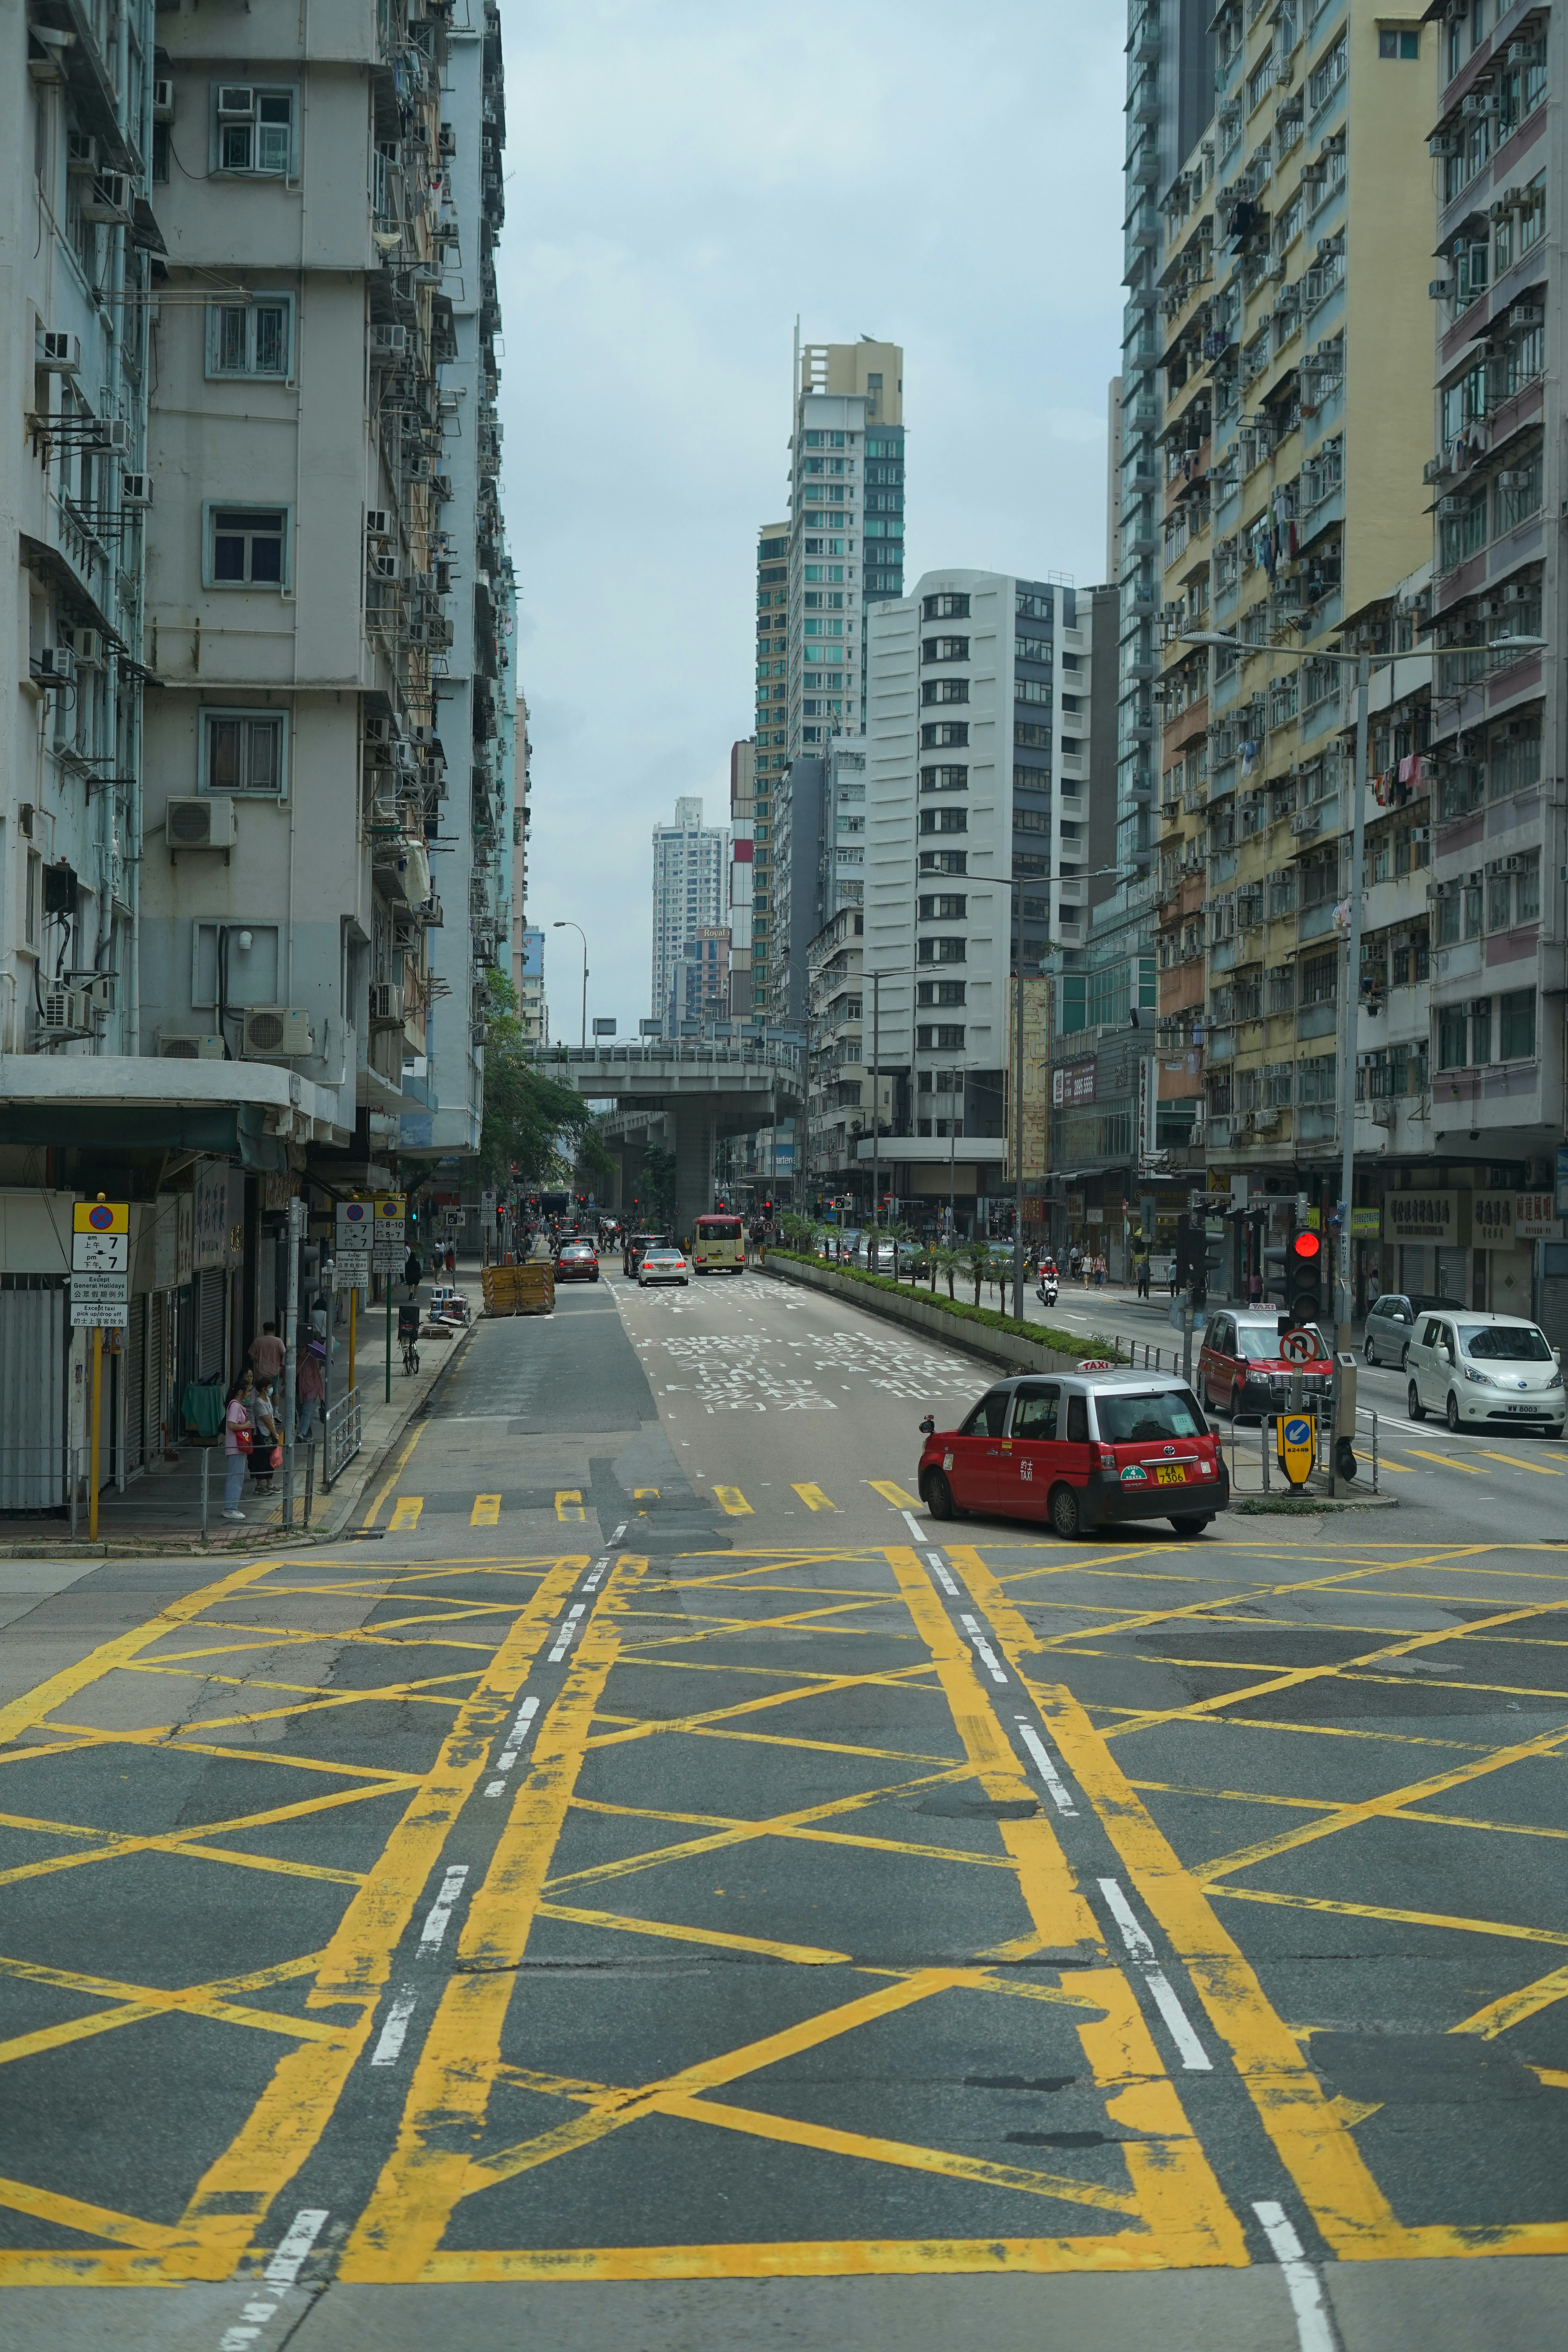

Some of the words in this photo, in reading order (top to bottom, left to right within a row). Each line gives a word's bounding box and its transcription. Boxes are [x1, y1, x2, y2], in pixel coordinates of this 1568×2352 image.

[1074, 1078, 1083, 1096] 2895
[1083, 1076, 1093, 1094] 5555
[361, 1225, 367, 1234] 7
[109, 1237, 118, 1249] 7
[361, 1239, 367, 1247] 7
[1342, 1236, 1346, 1244] BF
[109, 1257, 117, 1269] 7
[1083, 1361, 1108, 1370] TAXI
[666, 1382, 751, 1391] KOK
[1021, 1459, 1033, 1470] 的士
[1164, 1466, 1176, 1475] ZA
[1020, 1470, 1032, 1481] TAXI
[1159, 1474, 1183, 1483] 7306
